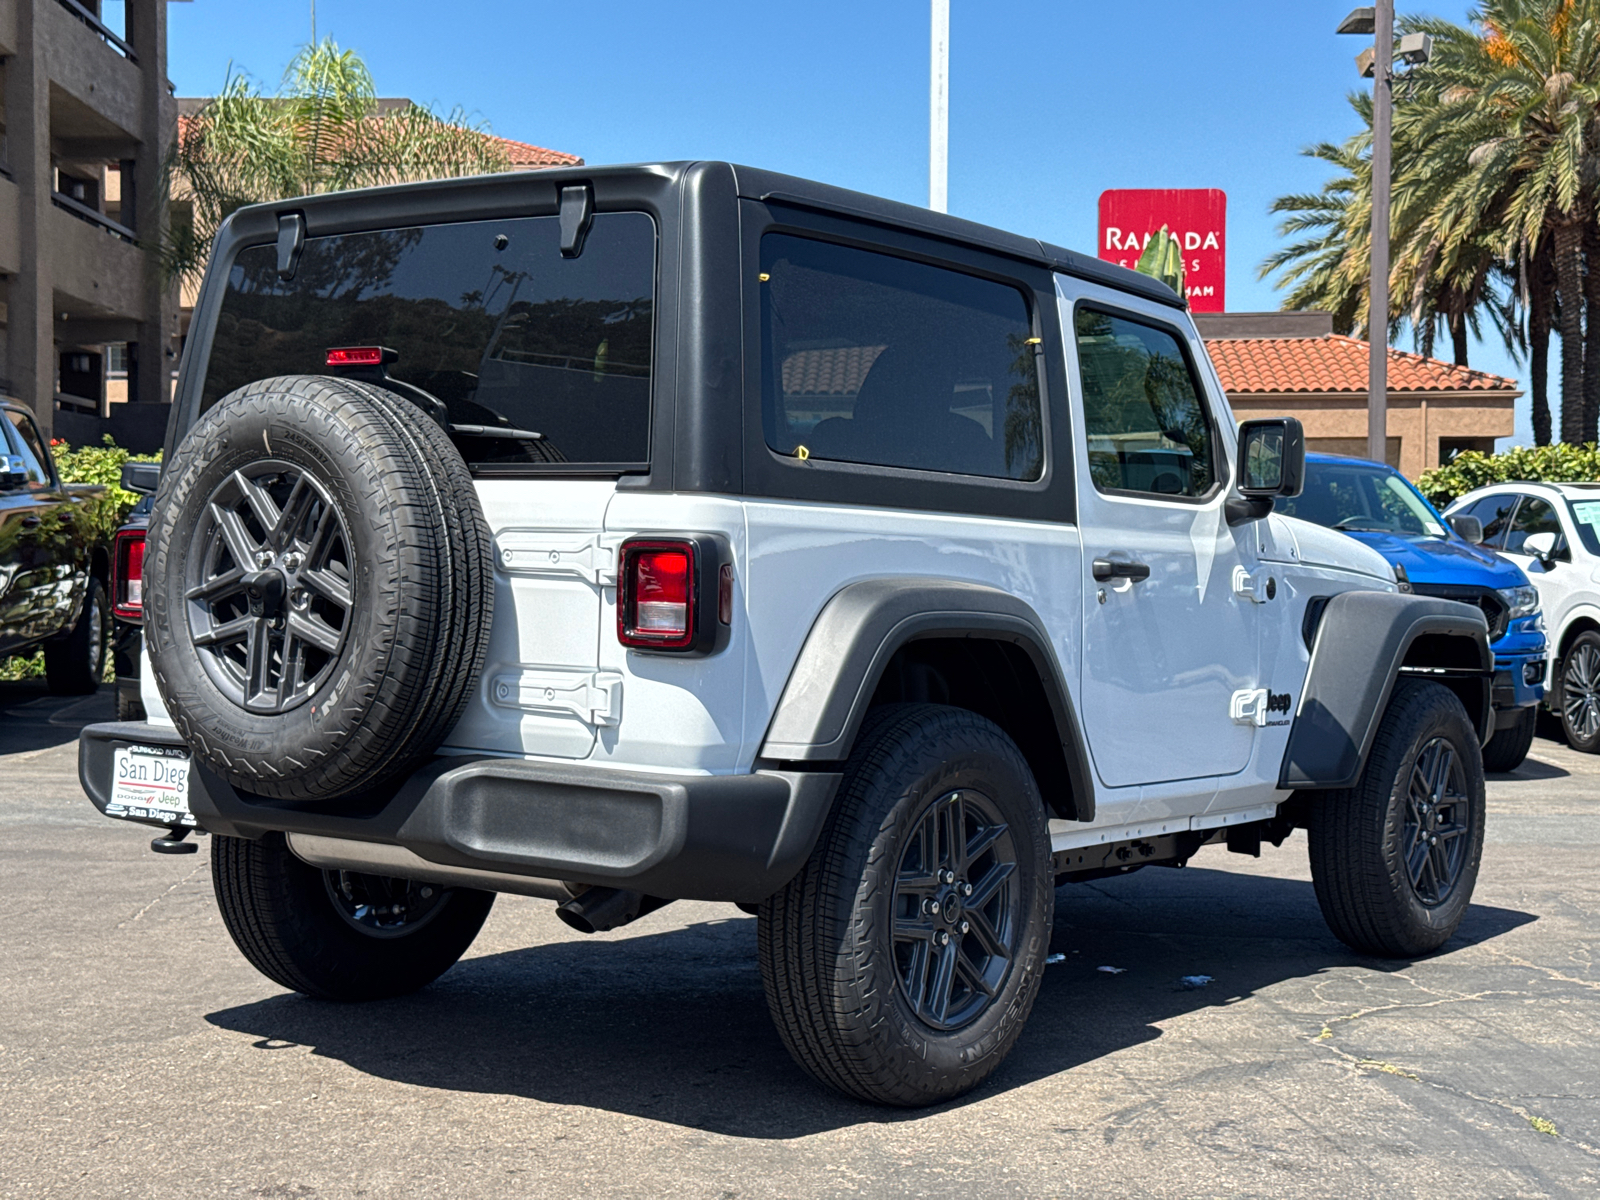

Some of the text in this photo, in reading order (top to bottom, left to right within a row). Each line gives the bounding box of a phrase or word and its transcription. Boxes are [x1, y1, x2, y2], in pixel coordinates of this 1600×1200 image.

[1266, 688, 1291, 715] Jeep
[119, 757, 187, 792] San Dieg
[158, 791, 181, 808] Jeep
[129, 806, 147, 817] San
[148, 808, 177, 823] Diego
